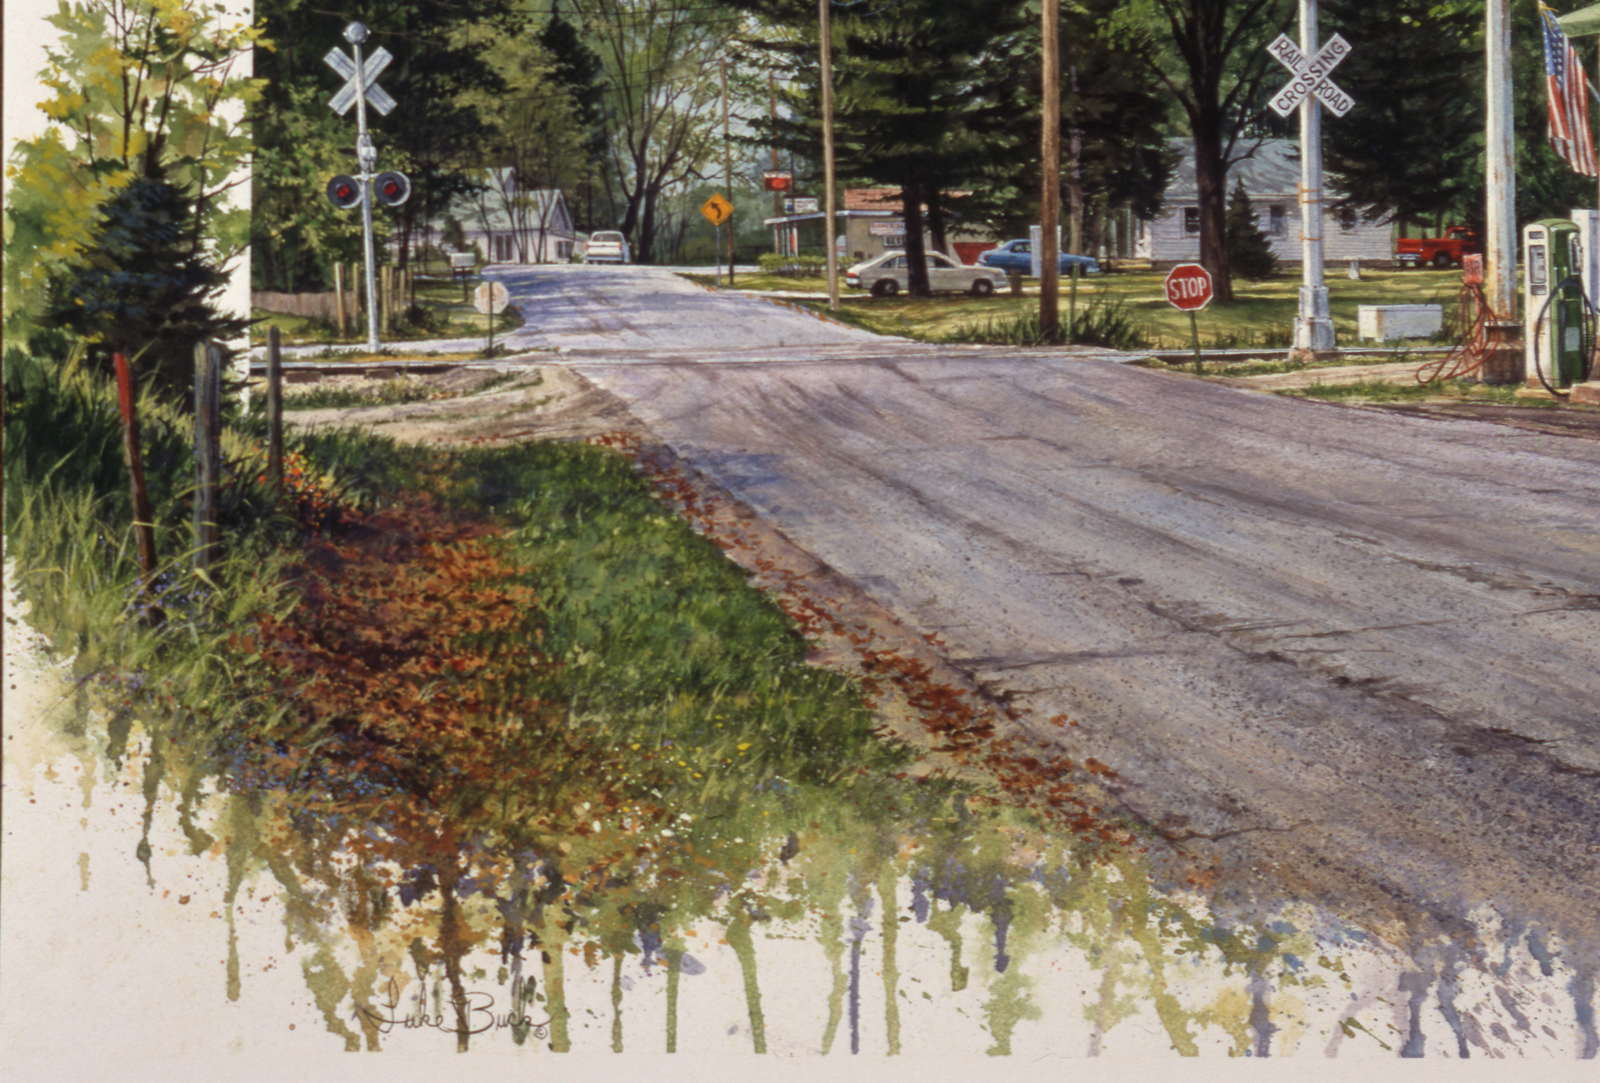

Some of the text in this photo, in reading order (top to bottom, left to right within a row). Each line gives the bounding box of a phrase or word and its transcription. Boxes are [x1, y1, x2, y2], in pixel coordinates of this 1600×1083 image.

[1274, 39, 1303, 72] RAIL
[1277, 41, 1345, 111] CROSSING
[1314, 79, 1349, 112] ROAD
[1169, 276, 1207, 300] STOP
